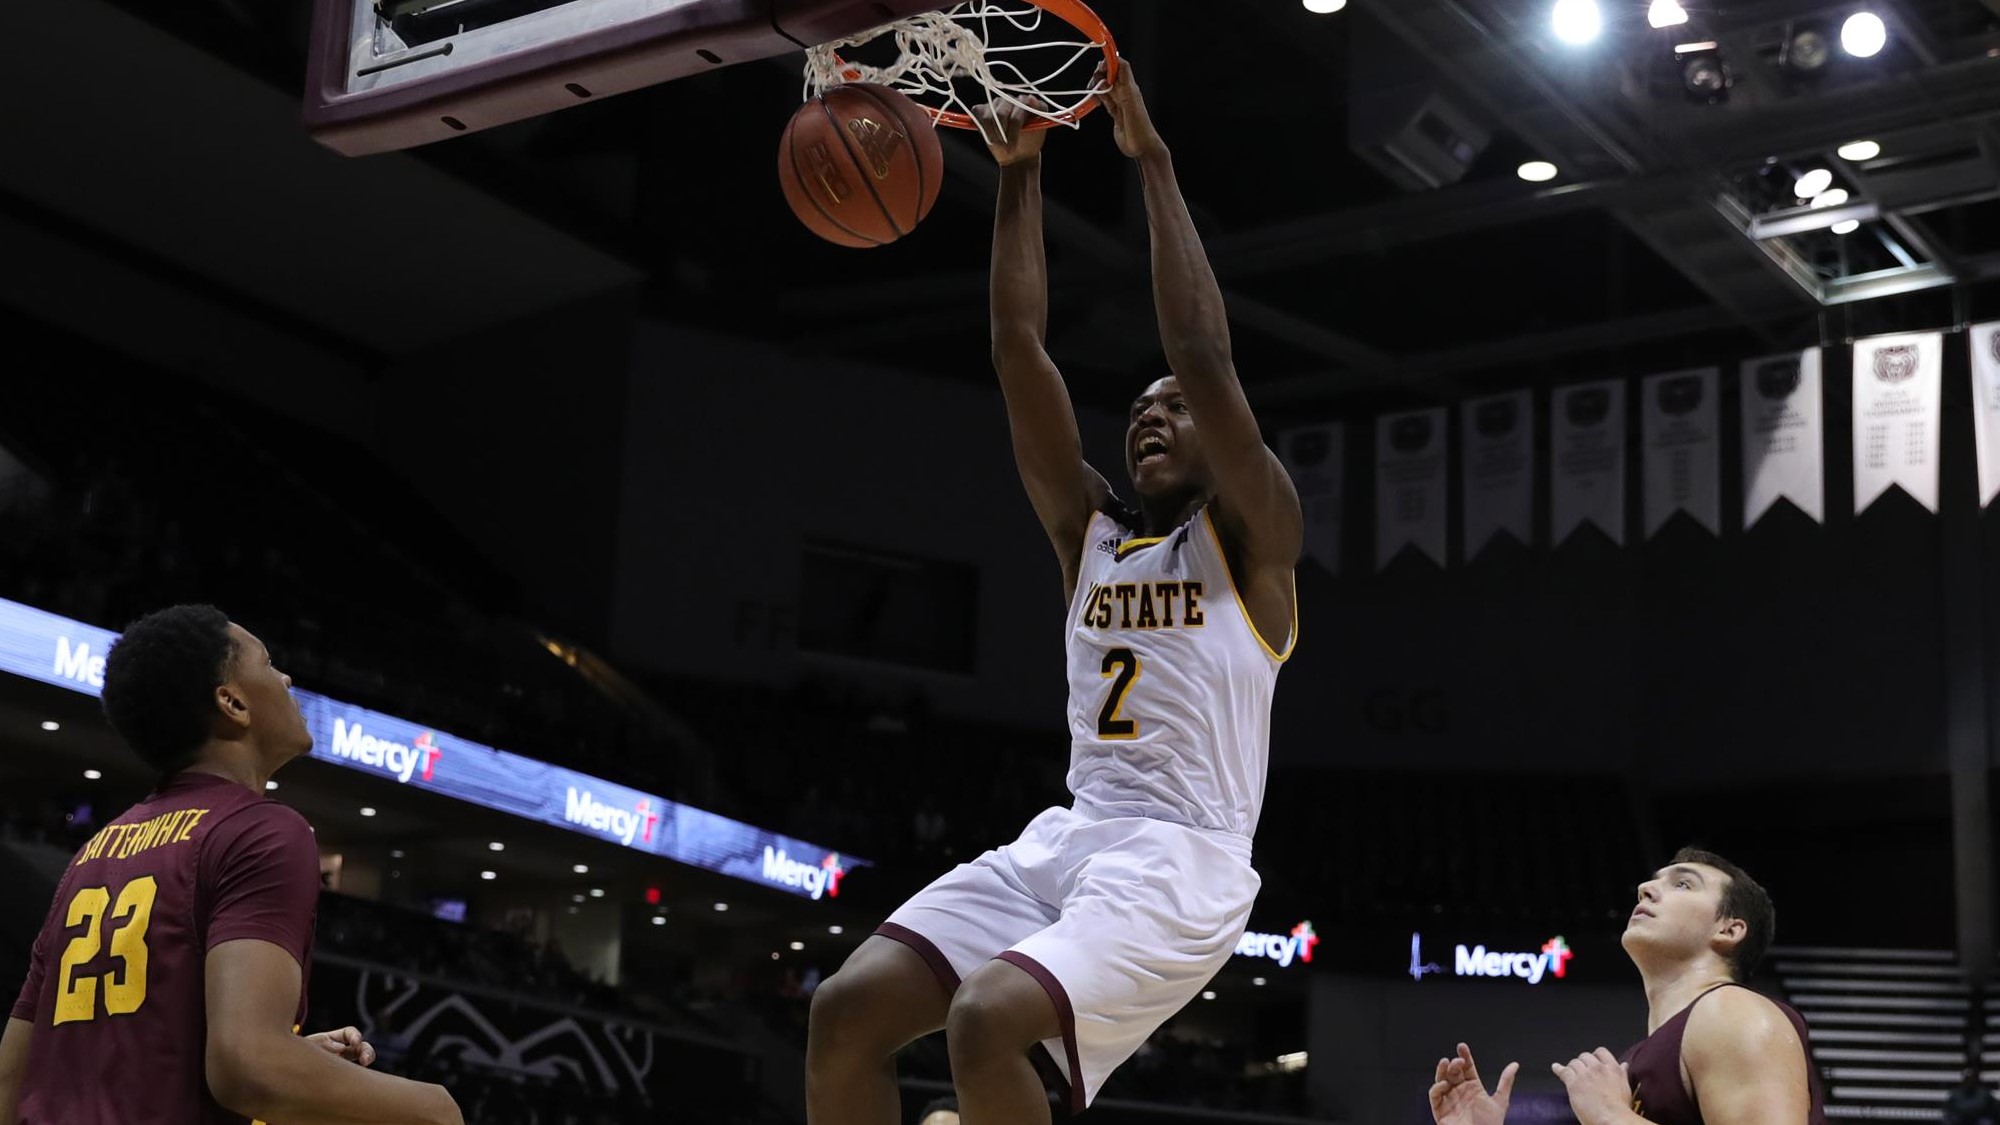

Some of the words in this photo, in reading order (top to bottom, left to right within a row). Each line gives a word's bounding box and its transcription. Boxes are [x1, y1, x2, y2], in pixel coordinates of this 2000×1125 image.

[54, 635, 106, 688] Me
[1097, 648, 1142, 740] 2
[331, 717, 419, 783] Mercy
[565, 786, 641, 846] Mercy
[762, 845, 828, 900] Mercy
[53, 875, 158, 1027] 23
[1234, 931, 1299, 968] ercy
[1455, 944, 1549, 985] Mercy
